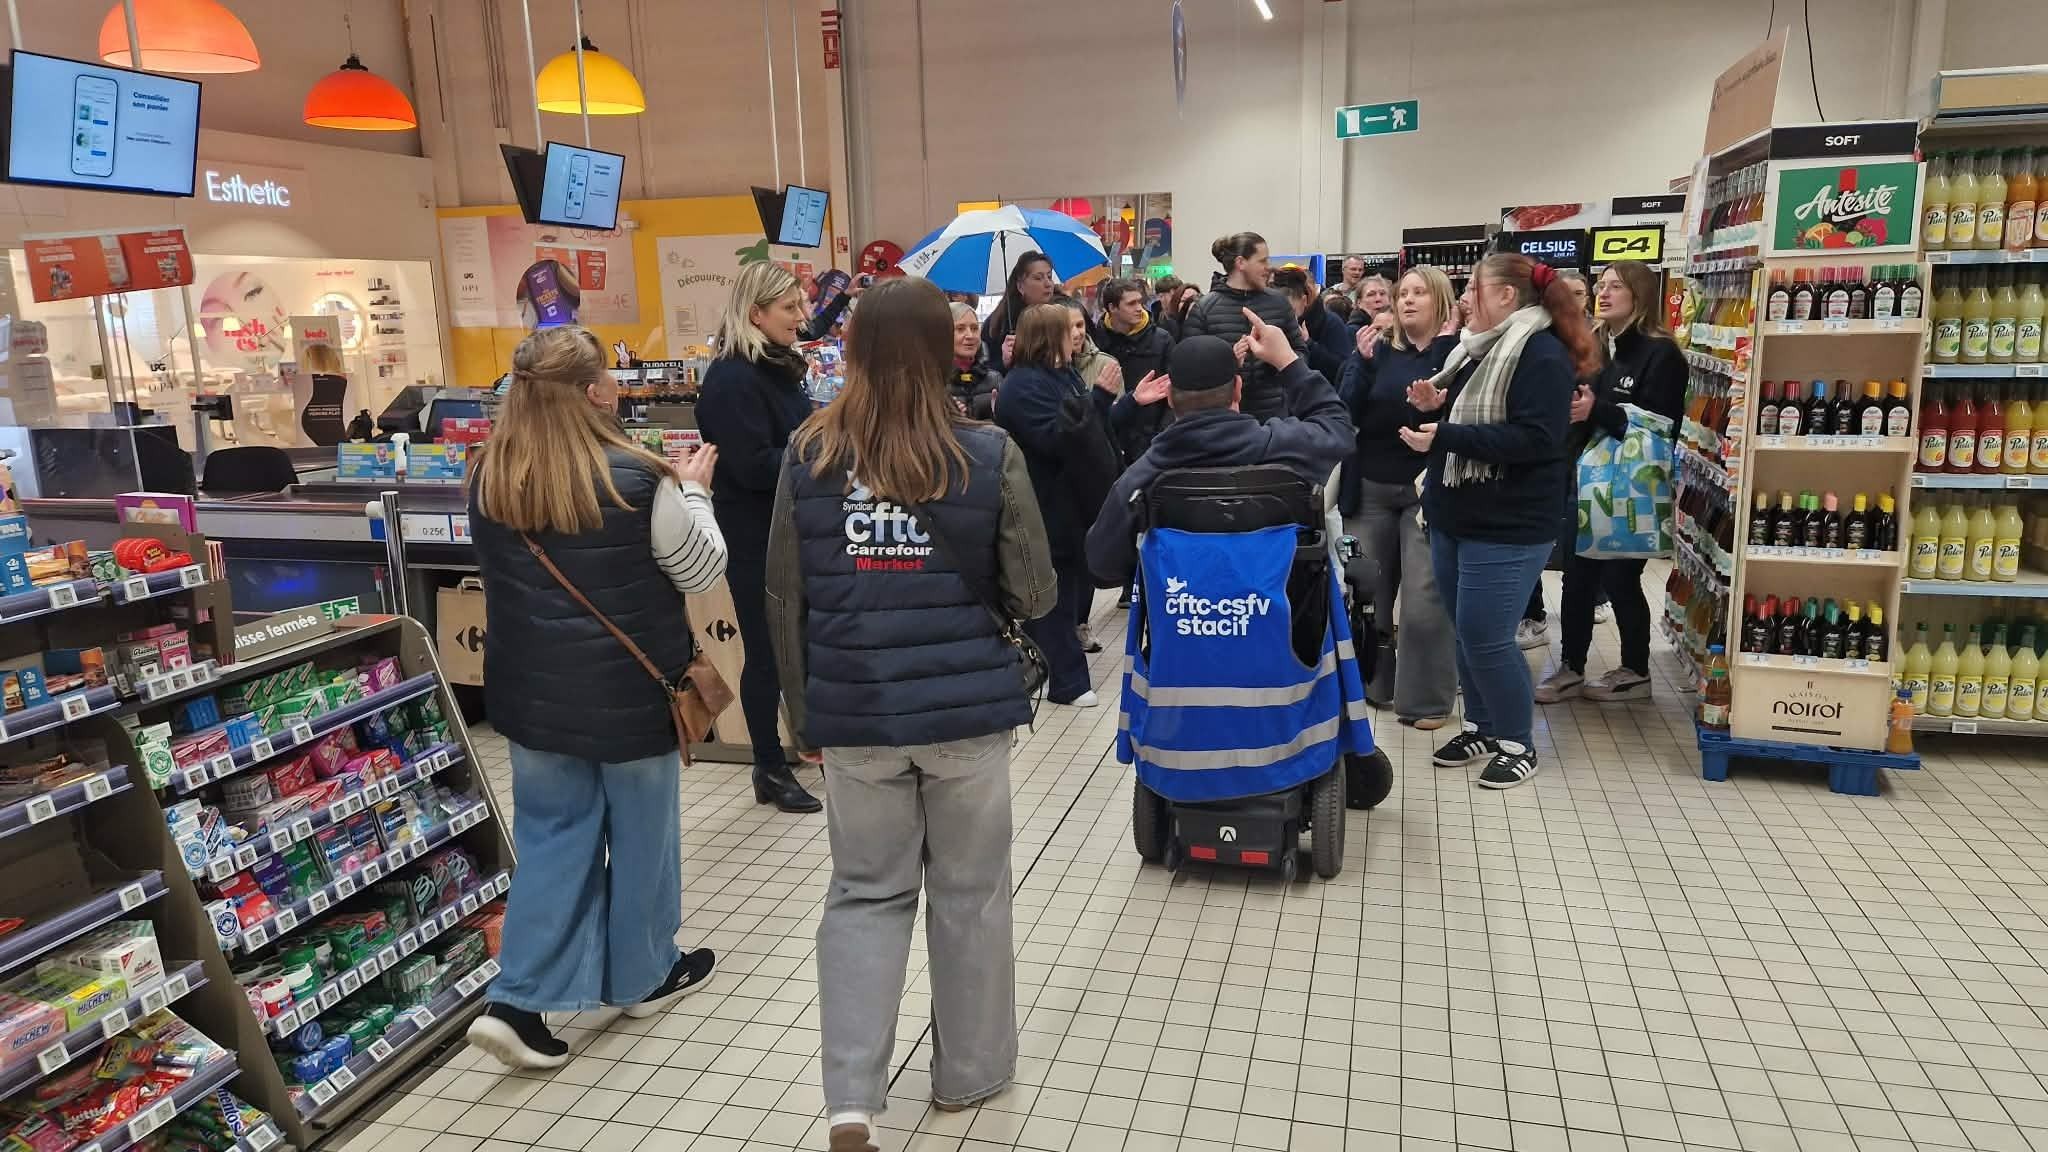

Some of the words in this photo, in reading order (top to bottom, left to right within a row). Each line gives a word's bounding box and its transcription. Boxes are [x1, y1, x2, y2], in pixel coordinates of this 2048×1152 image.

[1825, 135, 1859, 146] SOFT
[206, 170, 290, 207] Esthetic
[1794, 185, 1899, 221] Antésite
[1521, 240, 1577, 255] CELSIUS
[1602, 237, 1650, 254] C4
[842, 501, 874, 512] Syndicat
[845, 502, 930, 543] cftc
[846, 544, 933, 556] Carrefour
[856, 557, 925, 570] Market
[1166, 593, 1271, 615] cftc-csfv
[235, 631, 266, 649] isse
[266, 614, 318, 639] fermée
[1177, 615, 1249, 636] stacif
[1773, 701, 1844, 719] noirot
